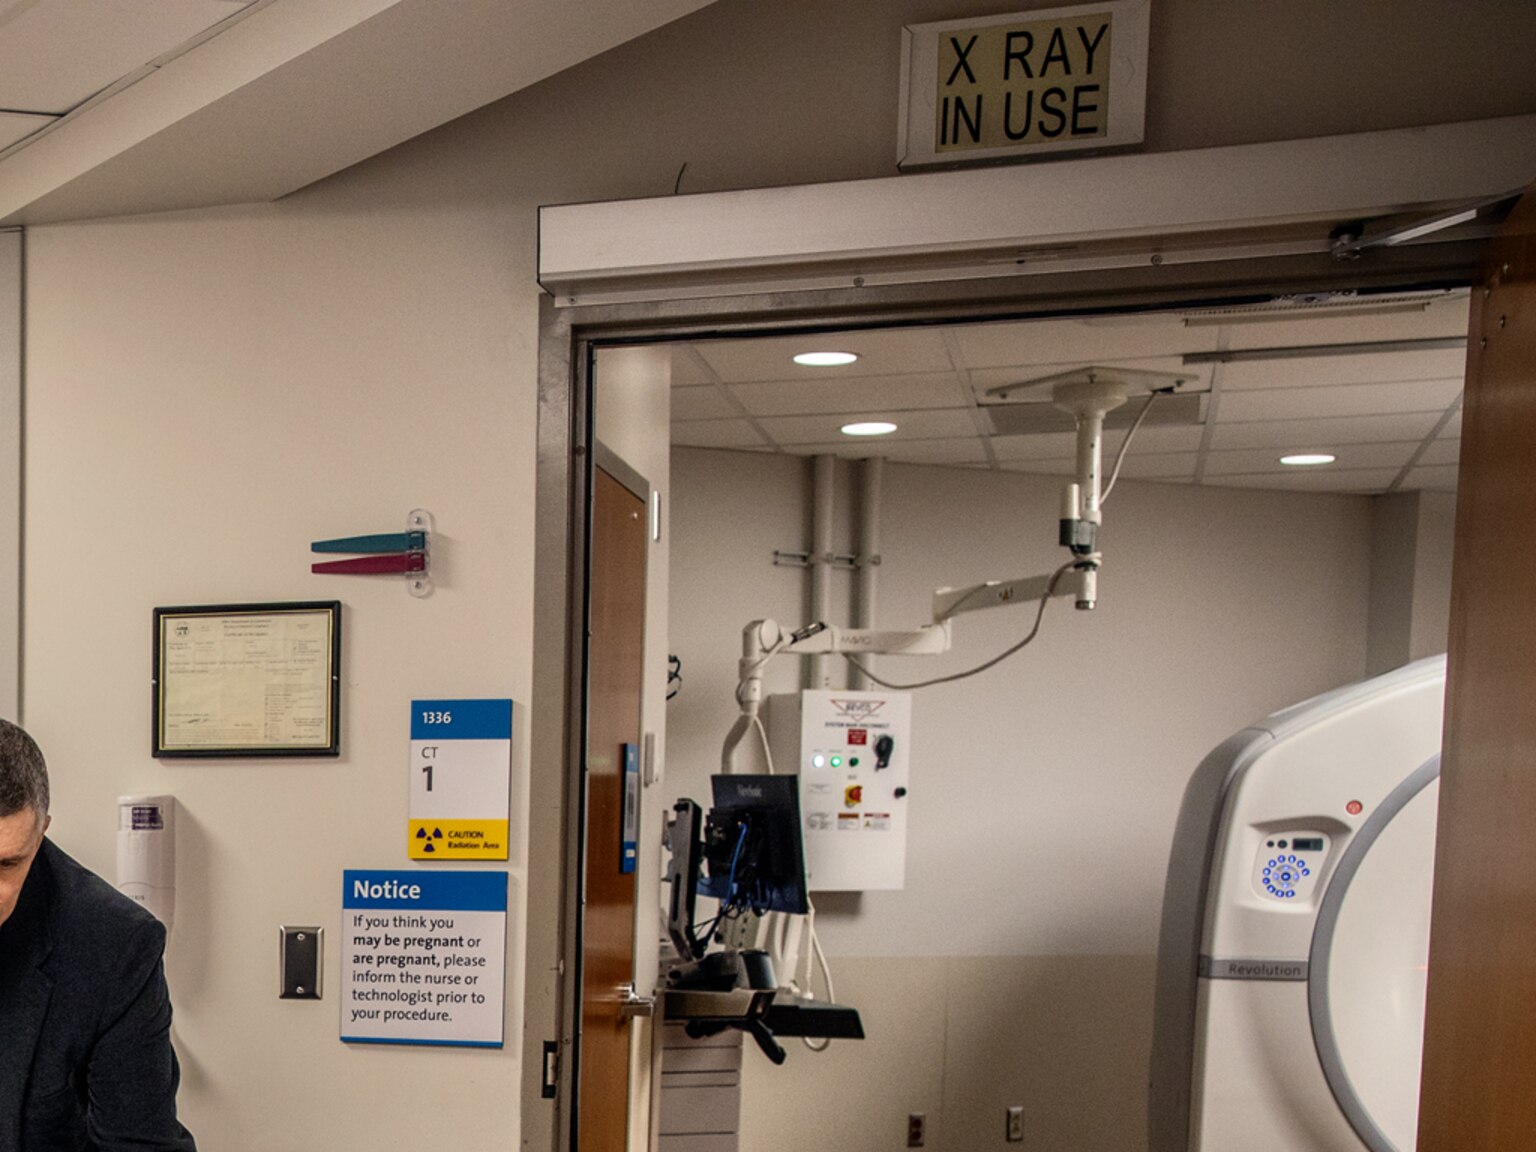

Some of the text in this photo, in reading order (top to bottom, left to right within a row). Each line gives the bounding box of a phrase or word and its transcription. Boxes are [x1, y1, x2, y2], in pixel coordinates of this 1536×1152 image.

[946, 23, 1109, 86] X RAY
[940, 84, 1100, 145] IN USE
[422, 711, 452, 724] 1336
[421, 746, 439, 759] CT
[422, 765, 433, 792] 1
[448, 831, 484, 839] CAUTION
[448, 841, 500, 849] Radiation Area
[353, 880, 421, 899] Notice
[353, 914, 454, 932] If you think you
[353, 934, 481, 950] may be pregnant or
[353, 953, 486, 968] are pregnant, please
[1228, 963, 1301, 976] Revolution
[352, 970, 479, 985] inform the nurse or
[352, 989, 485, 1006] technologist prior to
[351, 1008, 452, 1023] your procedure.
